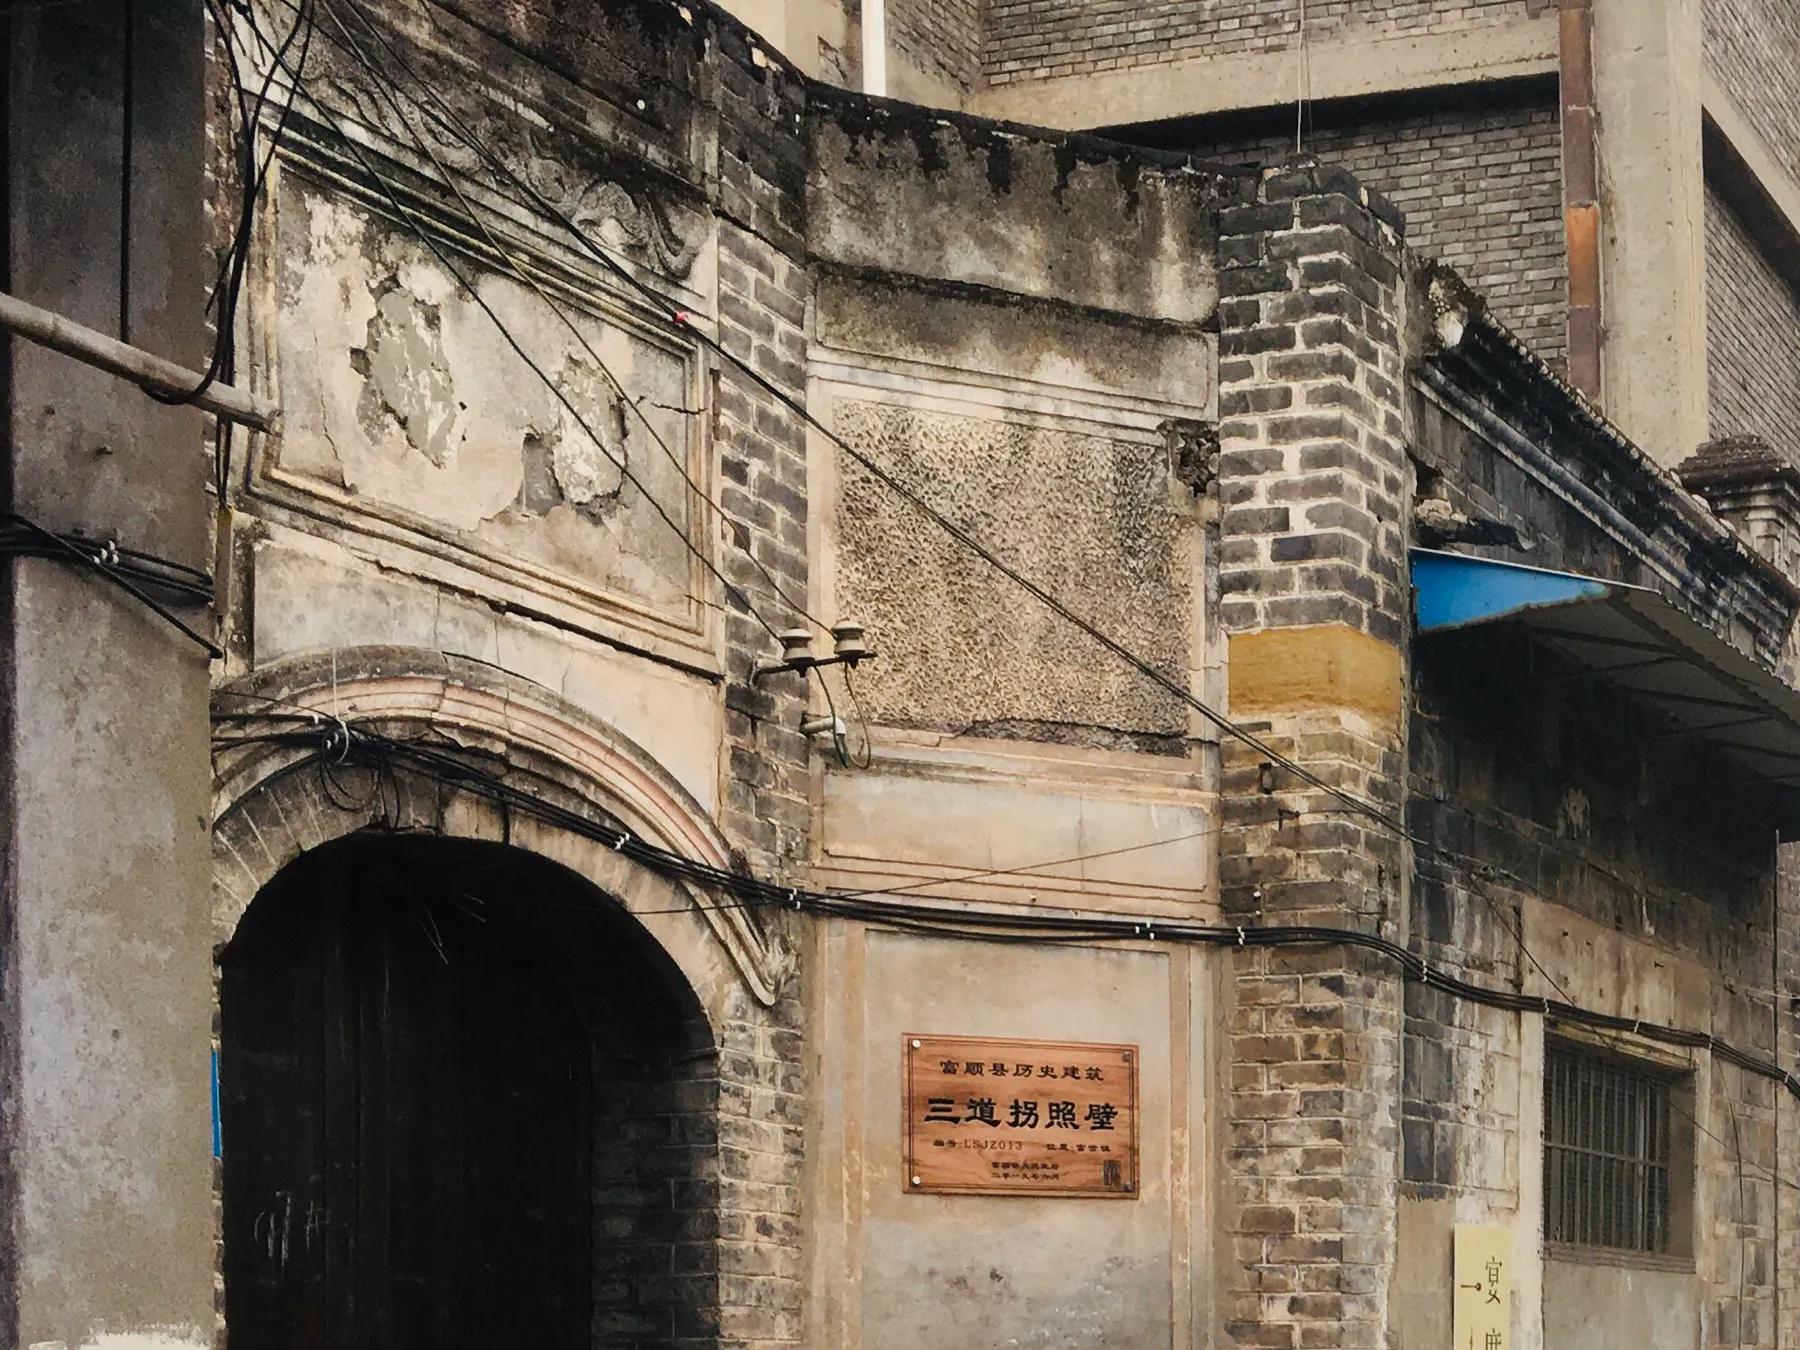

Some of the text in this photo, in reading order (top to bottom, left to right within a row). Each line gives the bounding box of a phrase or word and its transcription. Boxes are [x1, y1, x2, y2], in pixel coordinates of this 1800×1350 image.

[940, 1060, 1104, 1082] 富顺县历史建筑
[924, 1097, 1118, 1131] 三道拐照壁
